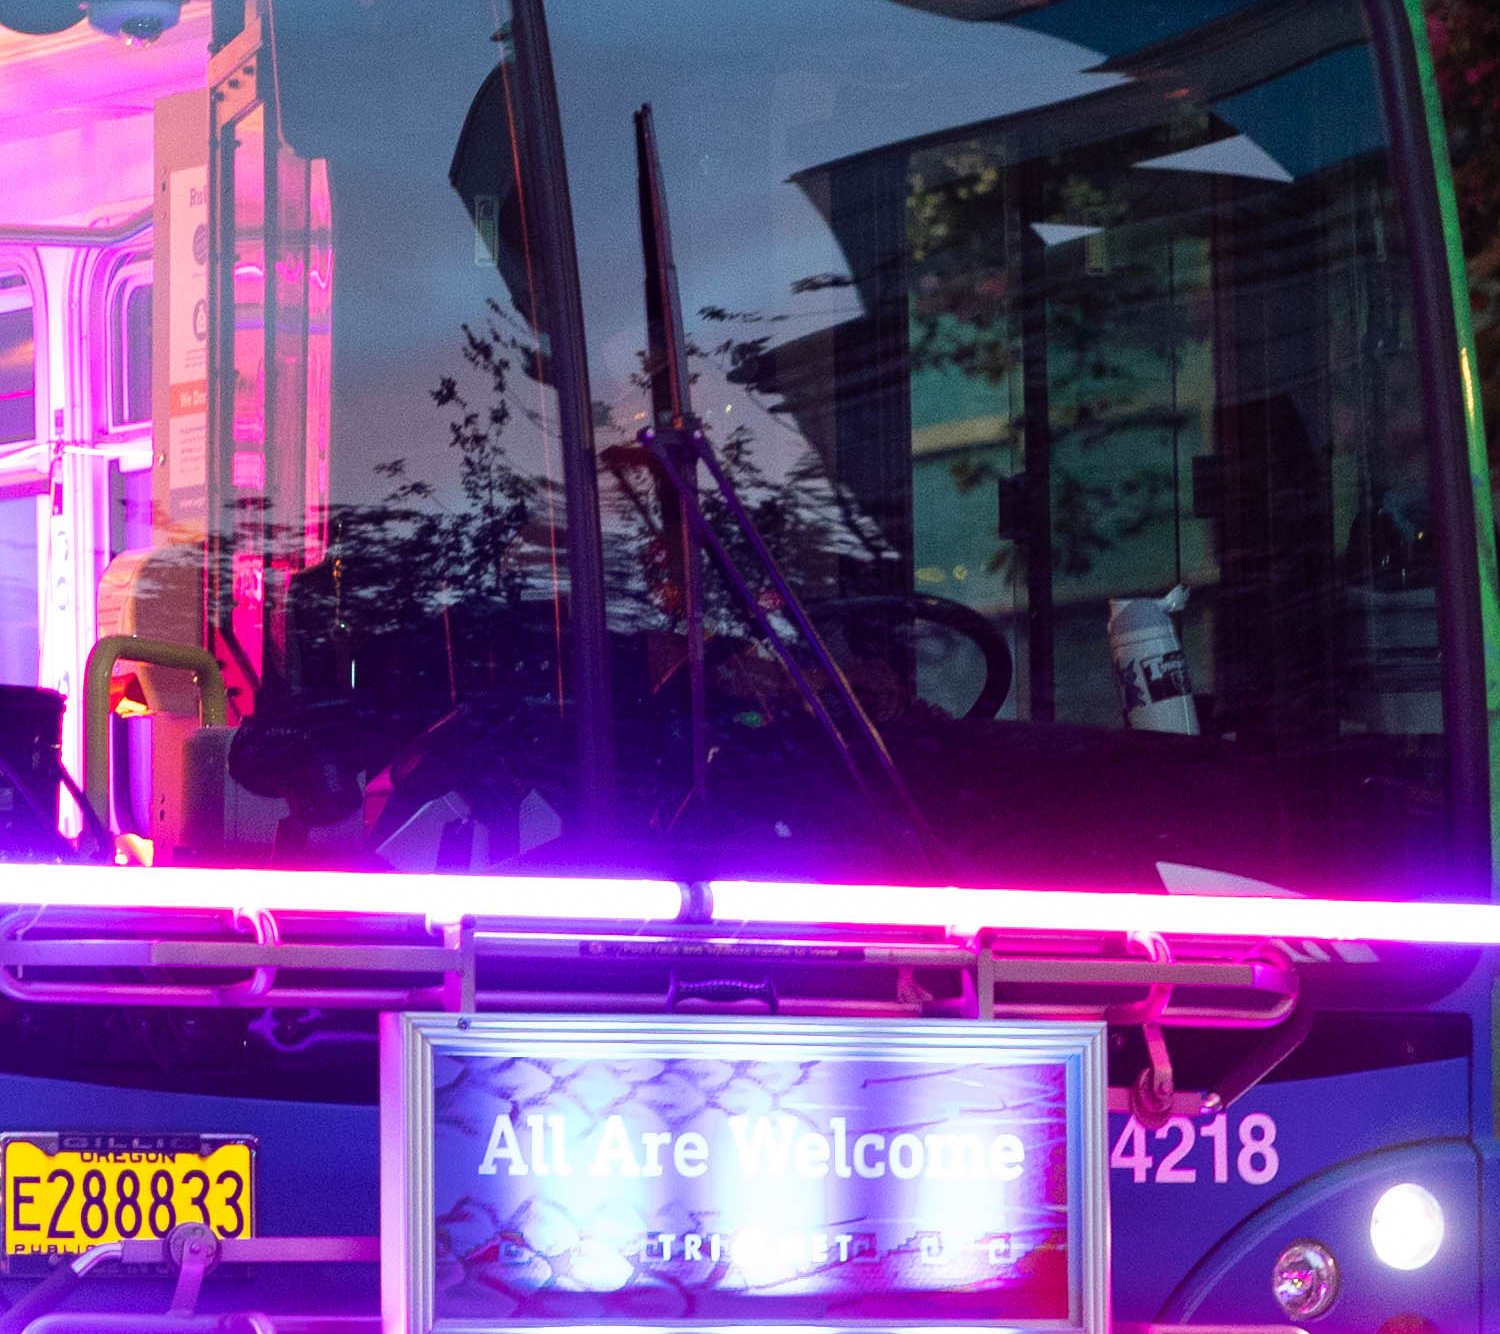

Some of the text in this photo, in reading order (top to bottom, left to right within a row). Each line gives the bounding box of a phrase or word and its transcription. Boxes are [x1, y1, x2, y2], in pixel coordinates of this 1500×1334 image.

[478, 1113, 1026, 1181] All Are Welcome
[1108, 1112, 1281, 1184] 4218
[12, 1168, 244, 1240] E288833
